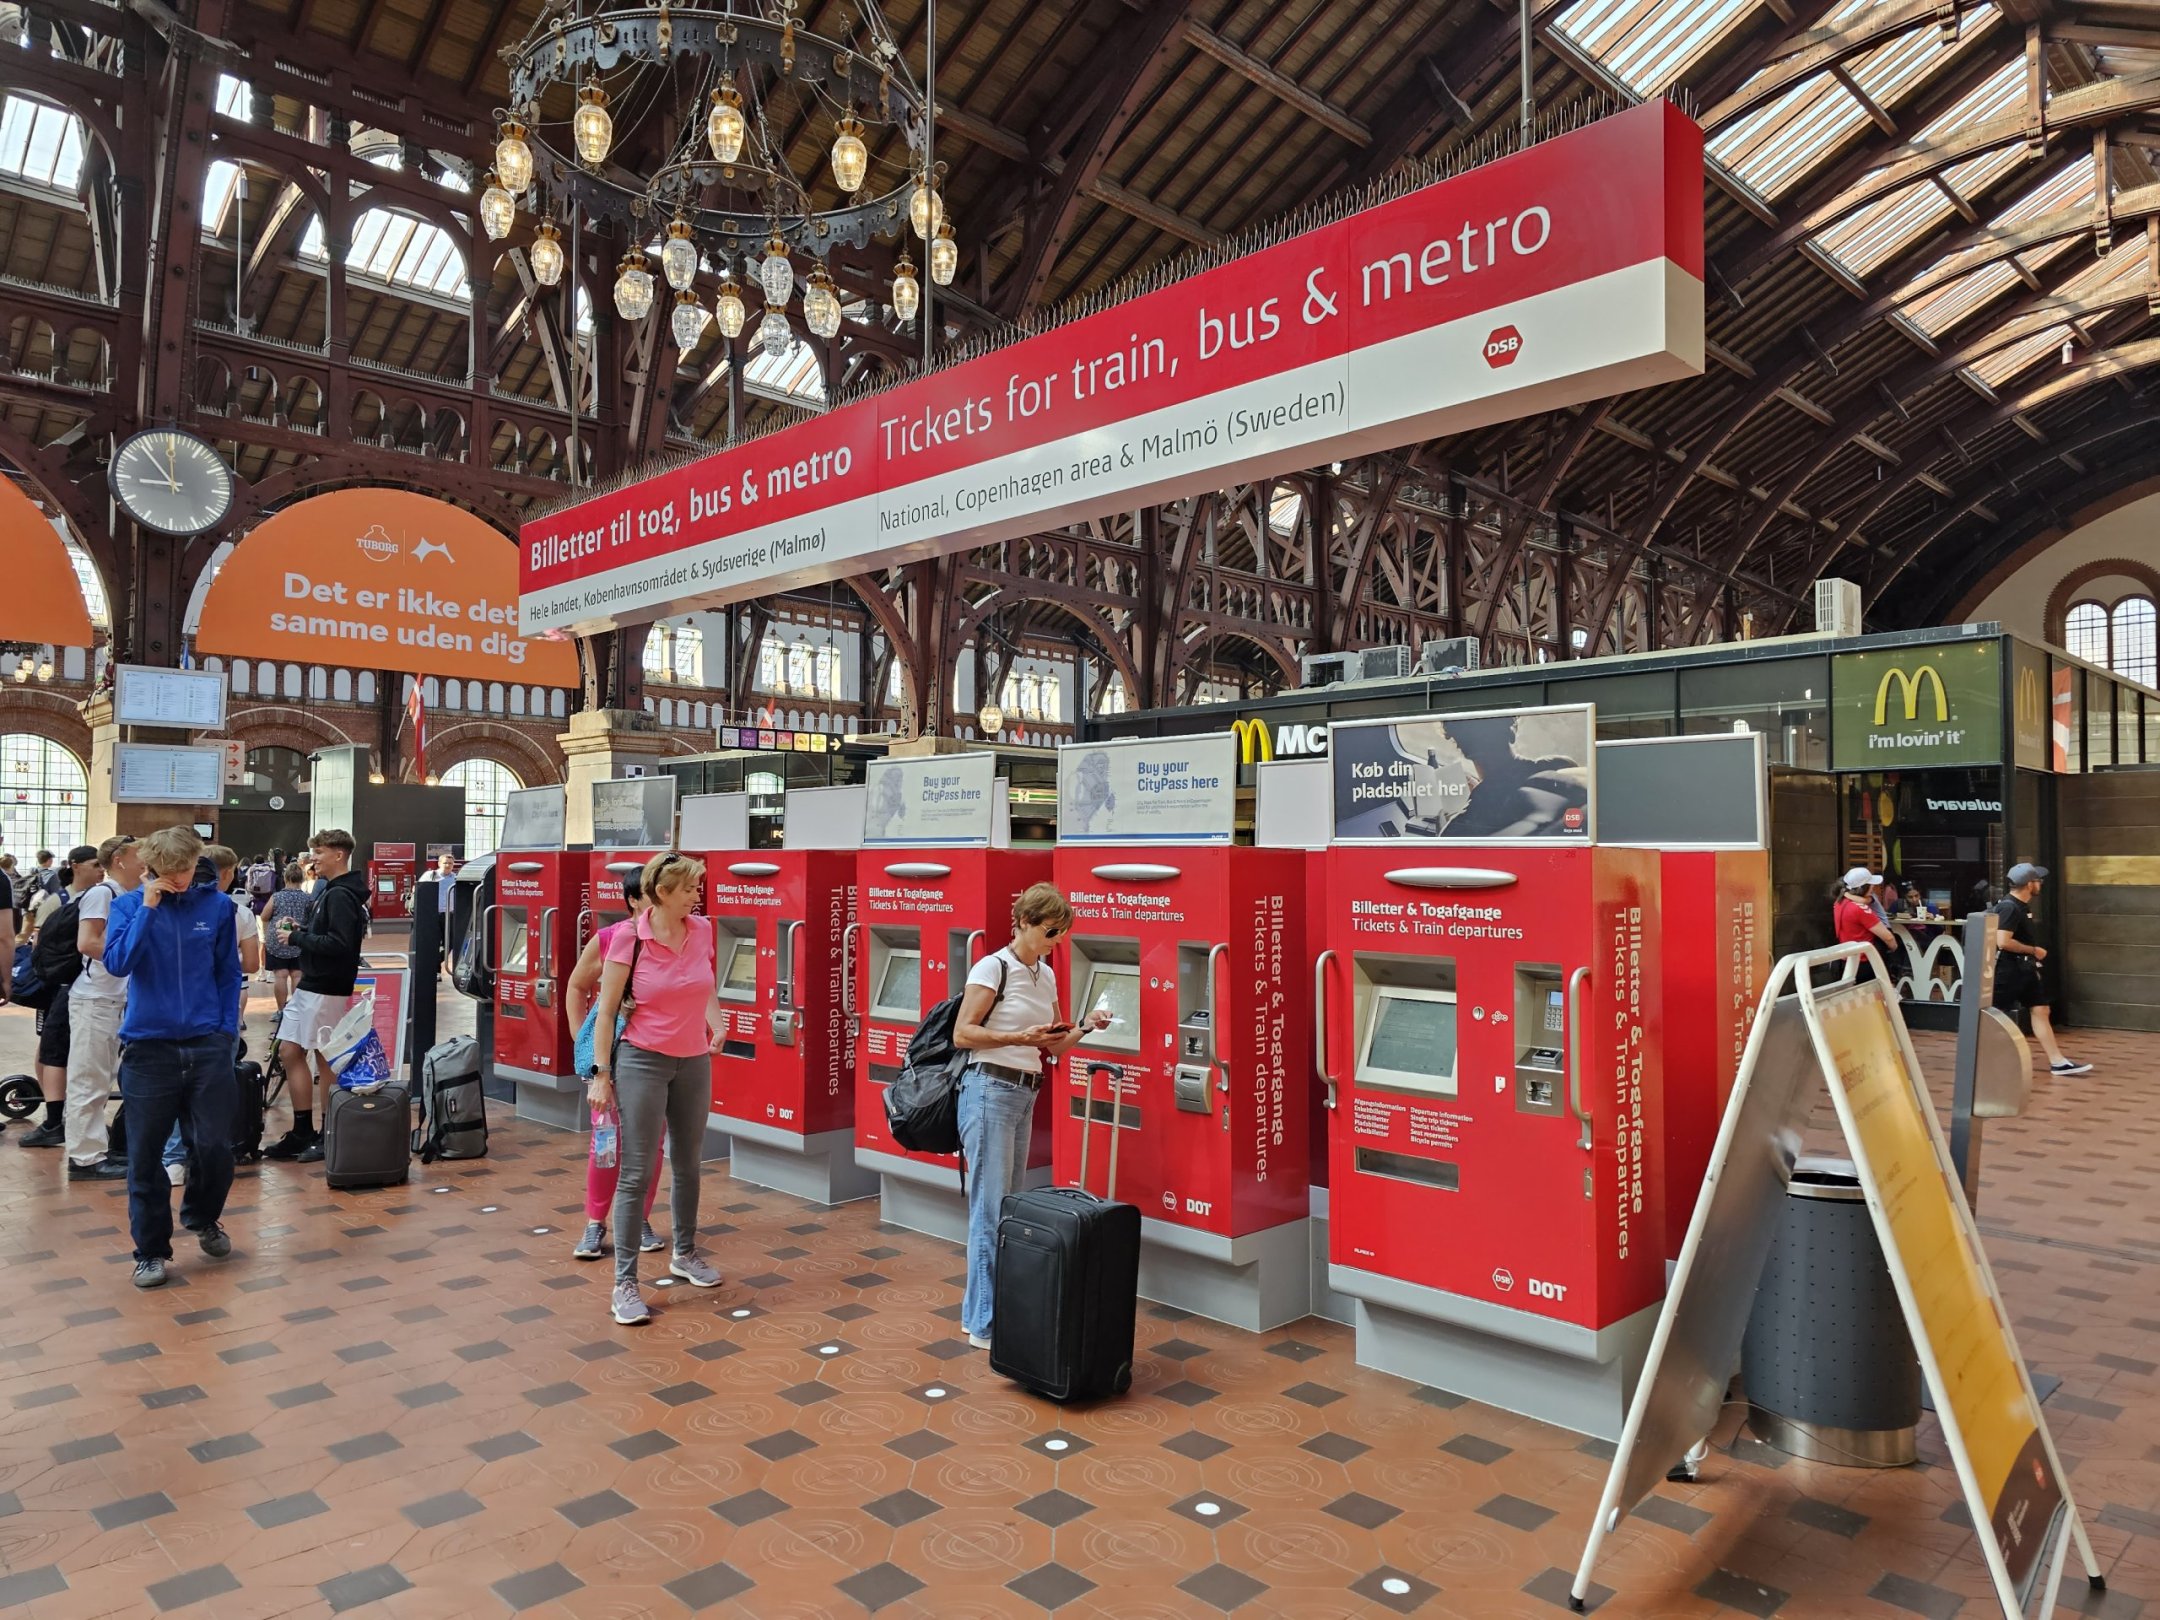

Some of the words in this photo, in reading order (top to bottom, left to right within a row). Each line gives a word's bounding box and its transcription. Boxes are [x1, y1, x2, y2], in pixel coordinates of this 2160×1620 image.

[880, 396, 992, 461] Tickets
[1006, 374, 1058, 422] for
[1071, 333, 1179, 400] train,
[1200, 297, 1280, 361] bus
[1302, 266, 1338, 325] &
[1361, 205, 1551, 307] metro
[1487, 336, 1519, 357] DSB
[880, 495, 949, 532] National,
[955, 467, 1063, 512] Copenhagen
[1070, 454, 1112, 482] area
[1119, 443, 1135, 469] &
[1142, 419, 1218, 464] Malmö
[1227, 380, 1345, 445] (Sweden)
[531, 525, 605, 572] Billetter
[610, 509, 631, 547] til
[638, 500, 681, 538] tog,
[690, 485, 732, 522] bus
[741, 469, 759, 506] &
[767, 446, 852, 498] metro
[356, 538, 399, 553] TUBORG
[530, 605, 549, 621] Hele
[551, 596, 581, 615] landet,
[584, 567, 688, 607] Københavnsområdet
[690, 562, 700, 580] &
[702, 548, 766, 580] Sydsverige
[770, 527, 826, 564] (Malmø)
[283, 572, 348, 605] Det
[355, 589, 390, 609] er
[397, 587, 461, 619] ikke
[467, 598, 518, 626] det
[270, 612, 389, 642] samme
[397, 623, 473, 653] uden
[480, 632, 528, 664] dig
[1868, 733, 1895, 749] i'm
[1897, 731, 1944, 747] lovin'
[1138, 761, 1160, 776] Buy
[1162, 761, 1190, 776] your
[1351, 761, 1384, 778] Køb
[1388, 760, 1413, 777] din
[923, 776, 939, 789] Buy
[941, 776, 961, 788] your
[1137, 777, 1189, 793] CityPass
[1191, 775, 1219, 789] here
[1352, 781, 1433, 802] pladsbillet
[1438, 780, 1466, 796] her
[922, 789, 959, 804] CityPass
[961, 788, 981, 800] here
[869, 887, 896, 897] Billetter
[896, 888, 902, 898] &
[903, 888, 944, 900] Togafgange
[1070, 891, 1105, 903] Billetter
[1107, 892, 1115, 904] &
[1116, 892, 1171, 907] Togafgange
[830, 885, 843, 942] Tickets
[869, 900, 891, 910] Tickets
[892, 901, 898, 911] &
[899, 901, 915, 911] Train
[916, 902, 954, 913] departures
[1071, 906, 1099, 918] Tickets
[1102, 907, 1109, 919] &
[1111, 907, 1132, 919] Train
[1135, 908, 1185, 922] departures
[1352, 900, 1403, 915] Billetter
[1406, 902, 1417, 916] &
[1420, 902, 1502, 920] Togafgange
[1254, 895, 1267, 972] Tickets
[1352, 918, 1395, 933] Tickets
[1399, 920, 1409, 933] &
[1412, 920, 1444, 935] Train
[1448, 922, 1523, 939] departures
[1271, 895, 1284, 985] Billetter
[1732, 902, 1742, 985] Tickets
[1744, 902, 1754, 999] Billetter
[830, 947, 842, 960] &
[1615, 907, 1627, 1001] Tickets
[1630, 907, 1641, 1017] Billetter
[830, 964, 842, 1003] Train
[1255, 980, 1268, 995] &
[1272, 991, 1284, 1009] &
[1733, 993, 1744, 1010] &
[1615, 1011, 1627, 1031] &
[1745, 1006, 1755, 1024] &
[1255, 1002, 1268, 1055] Train
[1631, 1025, 1642, 1046] &
[827, 1008, 842, 1096] departures
[1270, 1013, 1285, 1145] Togafgange
[1616, 1038, 1628, 1104] Train
[779, 1107, 794, 1120] DOT
[1253, 1063, 1269, 1182] departures
[1630, 1052, 1644, 1214] Togafgange
[1615, 1114, 1629, 1260] departures
[1186, 1198, 1212, 1216] DOT
[1495, 1274, 1512, 1285] DSB
[1528, 1278, 1567, 1302] DOT
